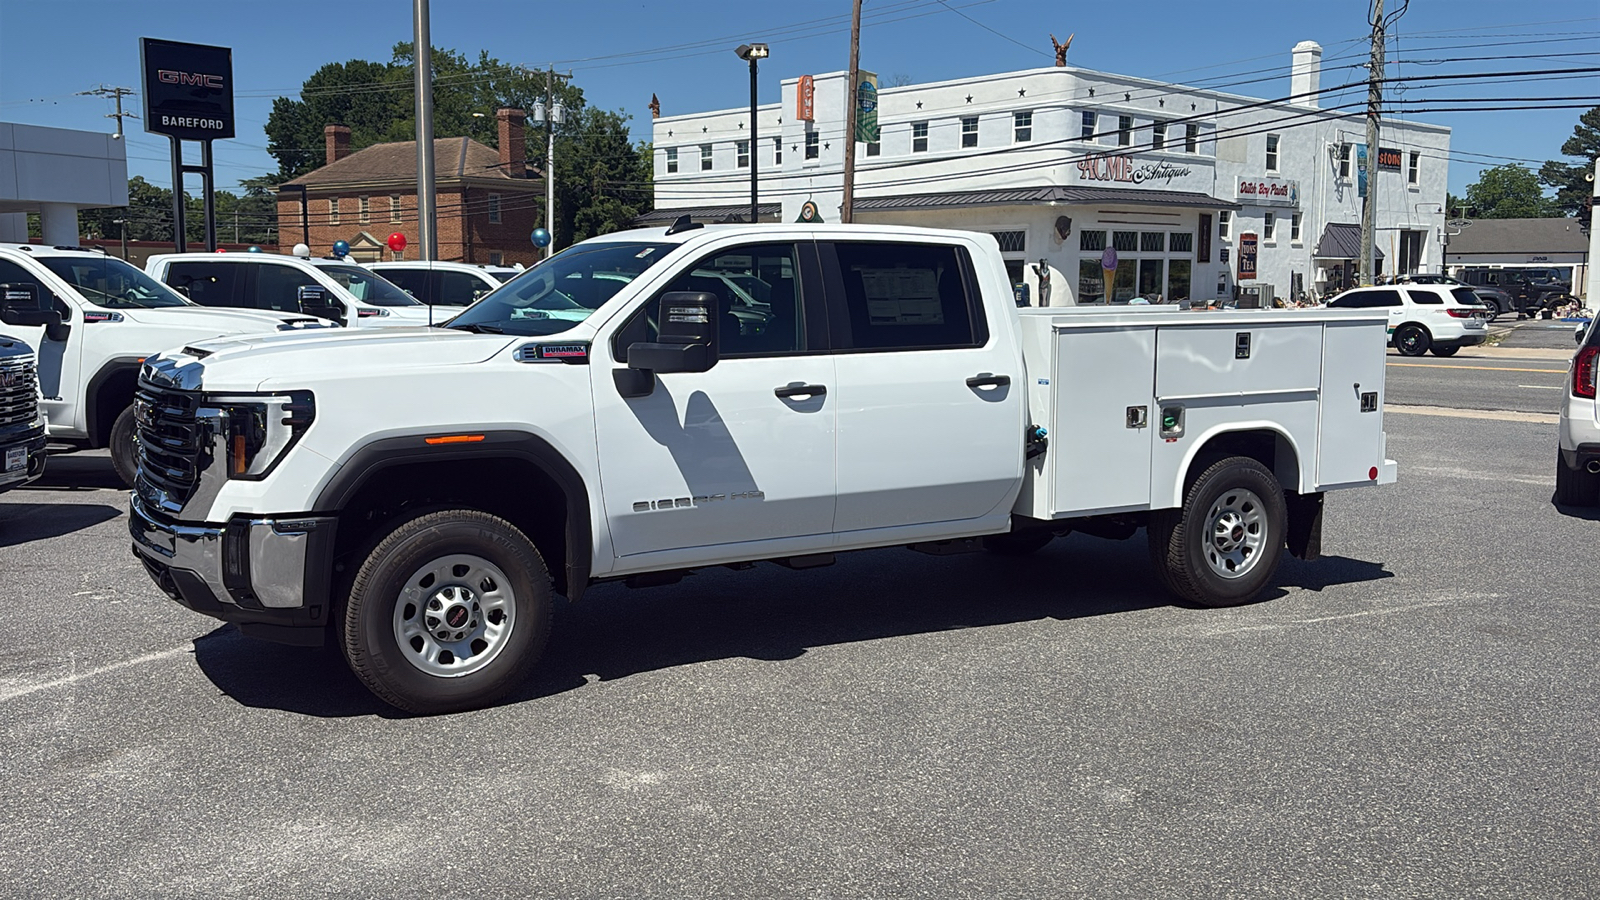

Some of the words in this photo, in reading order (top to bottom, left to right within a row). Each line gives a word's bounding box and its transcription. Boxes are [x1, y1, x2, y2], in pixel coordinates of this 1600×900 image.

[158, 69, 223, 88] GMC
[162, 115, 223, 130] BAREFORD
[1077, 152, 1133, 183] ACME
[1240, 181, 1257, 195] Dutch
[1258, 182, 1270, 198] Boy
[1270, 183, 1288, 197] Paints
[545, 345, 584, 353] DURAMAX
